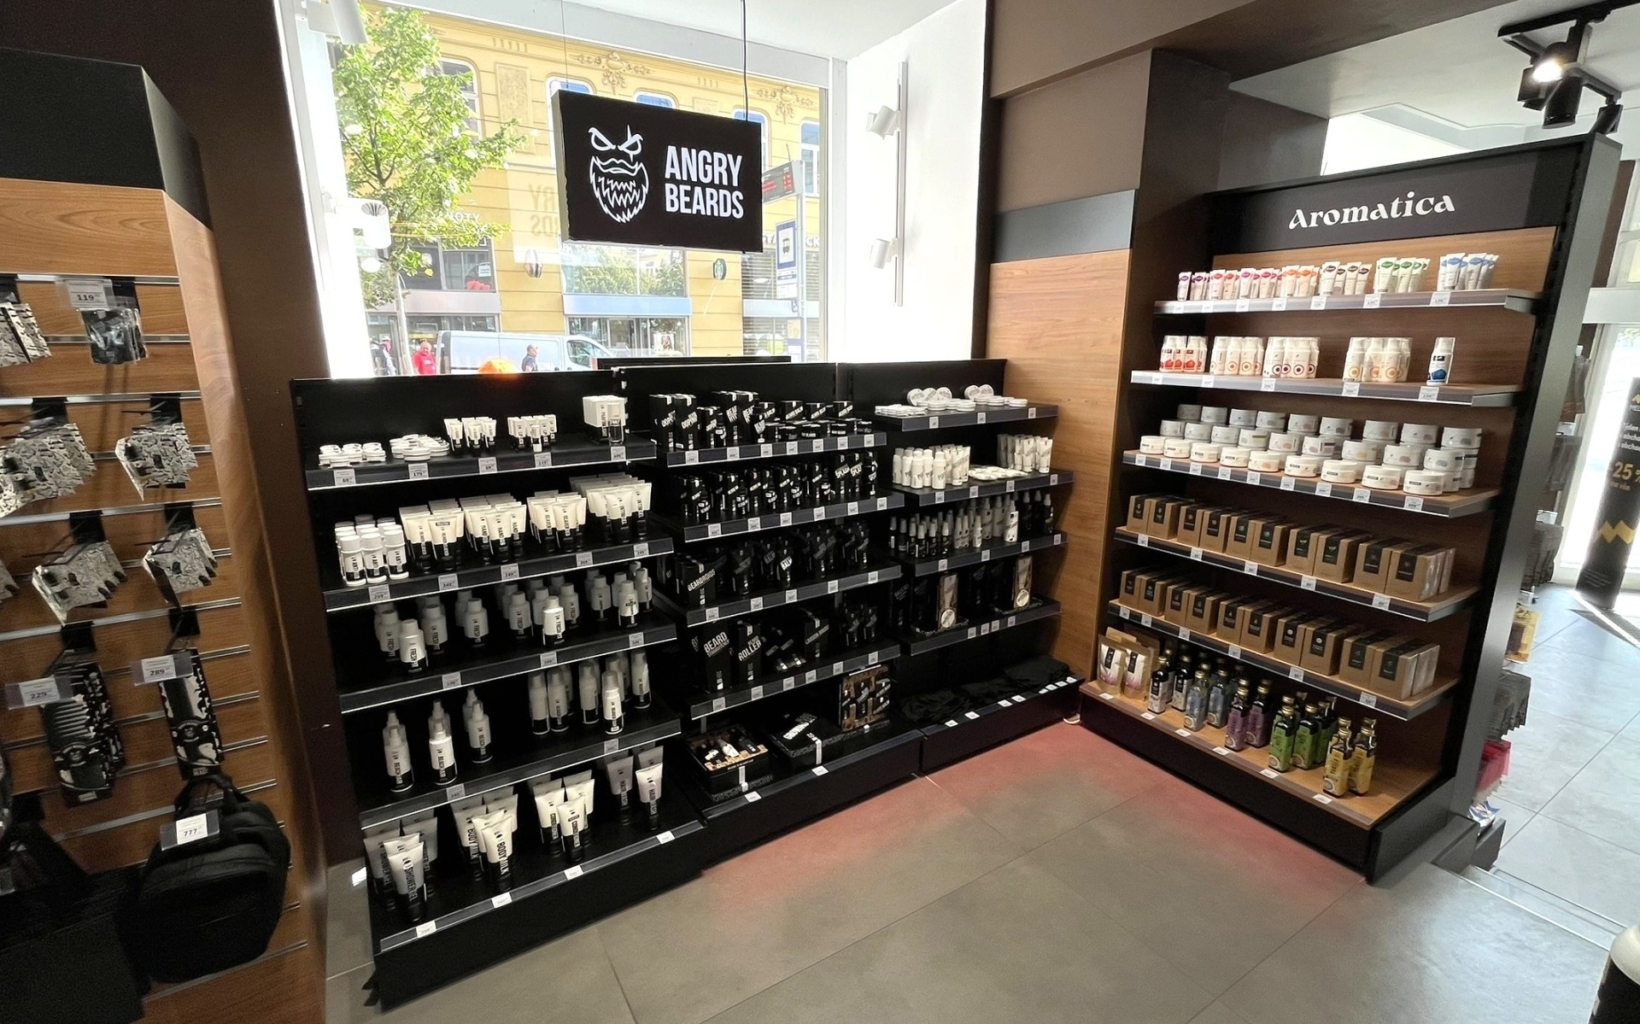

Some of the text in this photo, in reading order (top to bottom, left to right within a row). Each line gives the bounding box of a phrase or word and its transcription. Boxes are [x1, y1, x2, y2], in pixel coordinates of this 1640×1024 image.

[665, 145, 742, 187] ANGRY
[665, 183, 744, 219] BEARDS
[1288, 191, 1456, 230] Aromatica
[1613, 461, 1633, 480] 25
[703, 631, 728, 653] BEARD
[737, 639, 762, 662] ROLLER
[496, 841, 507, 858] BODY
